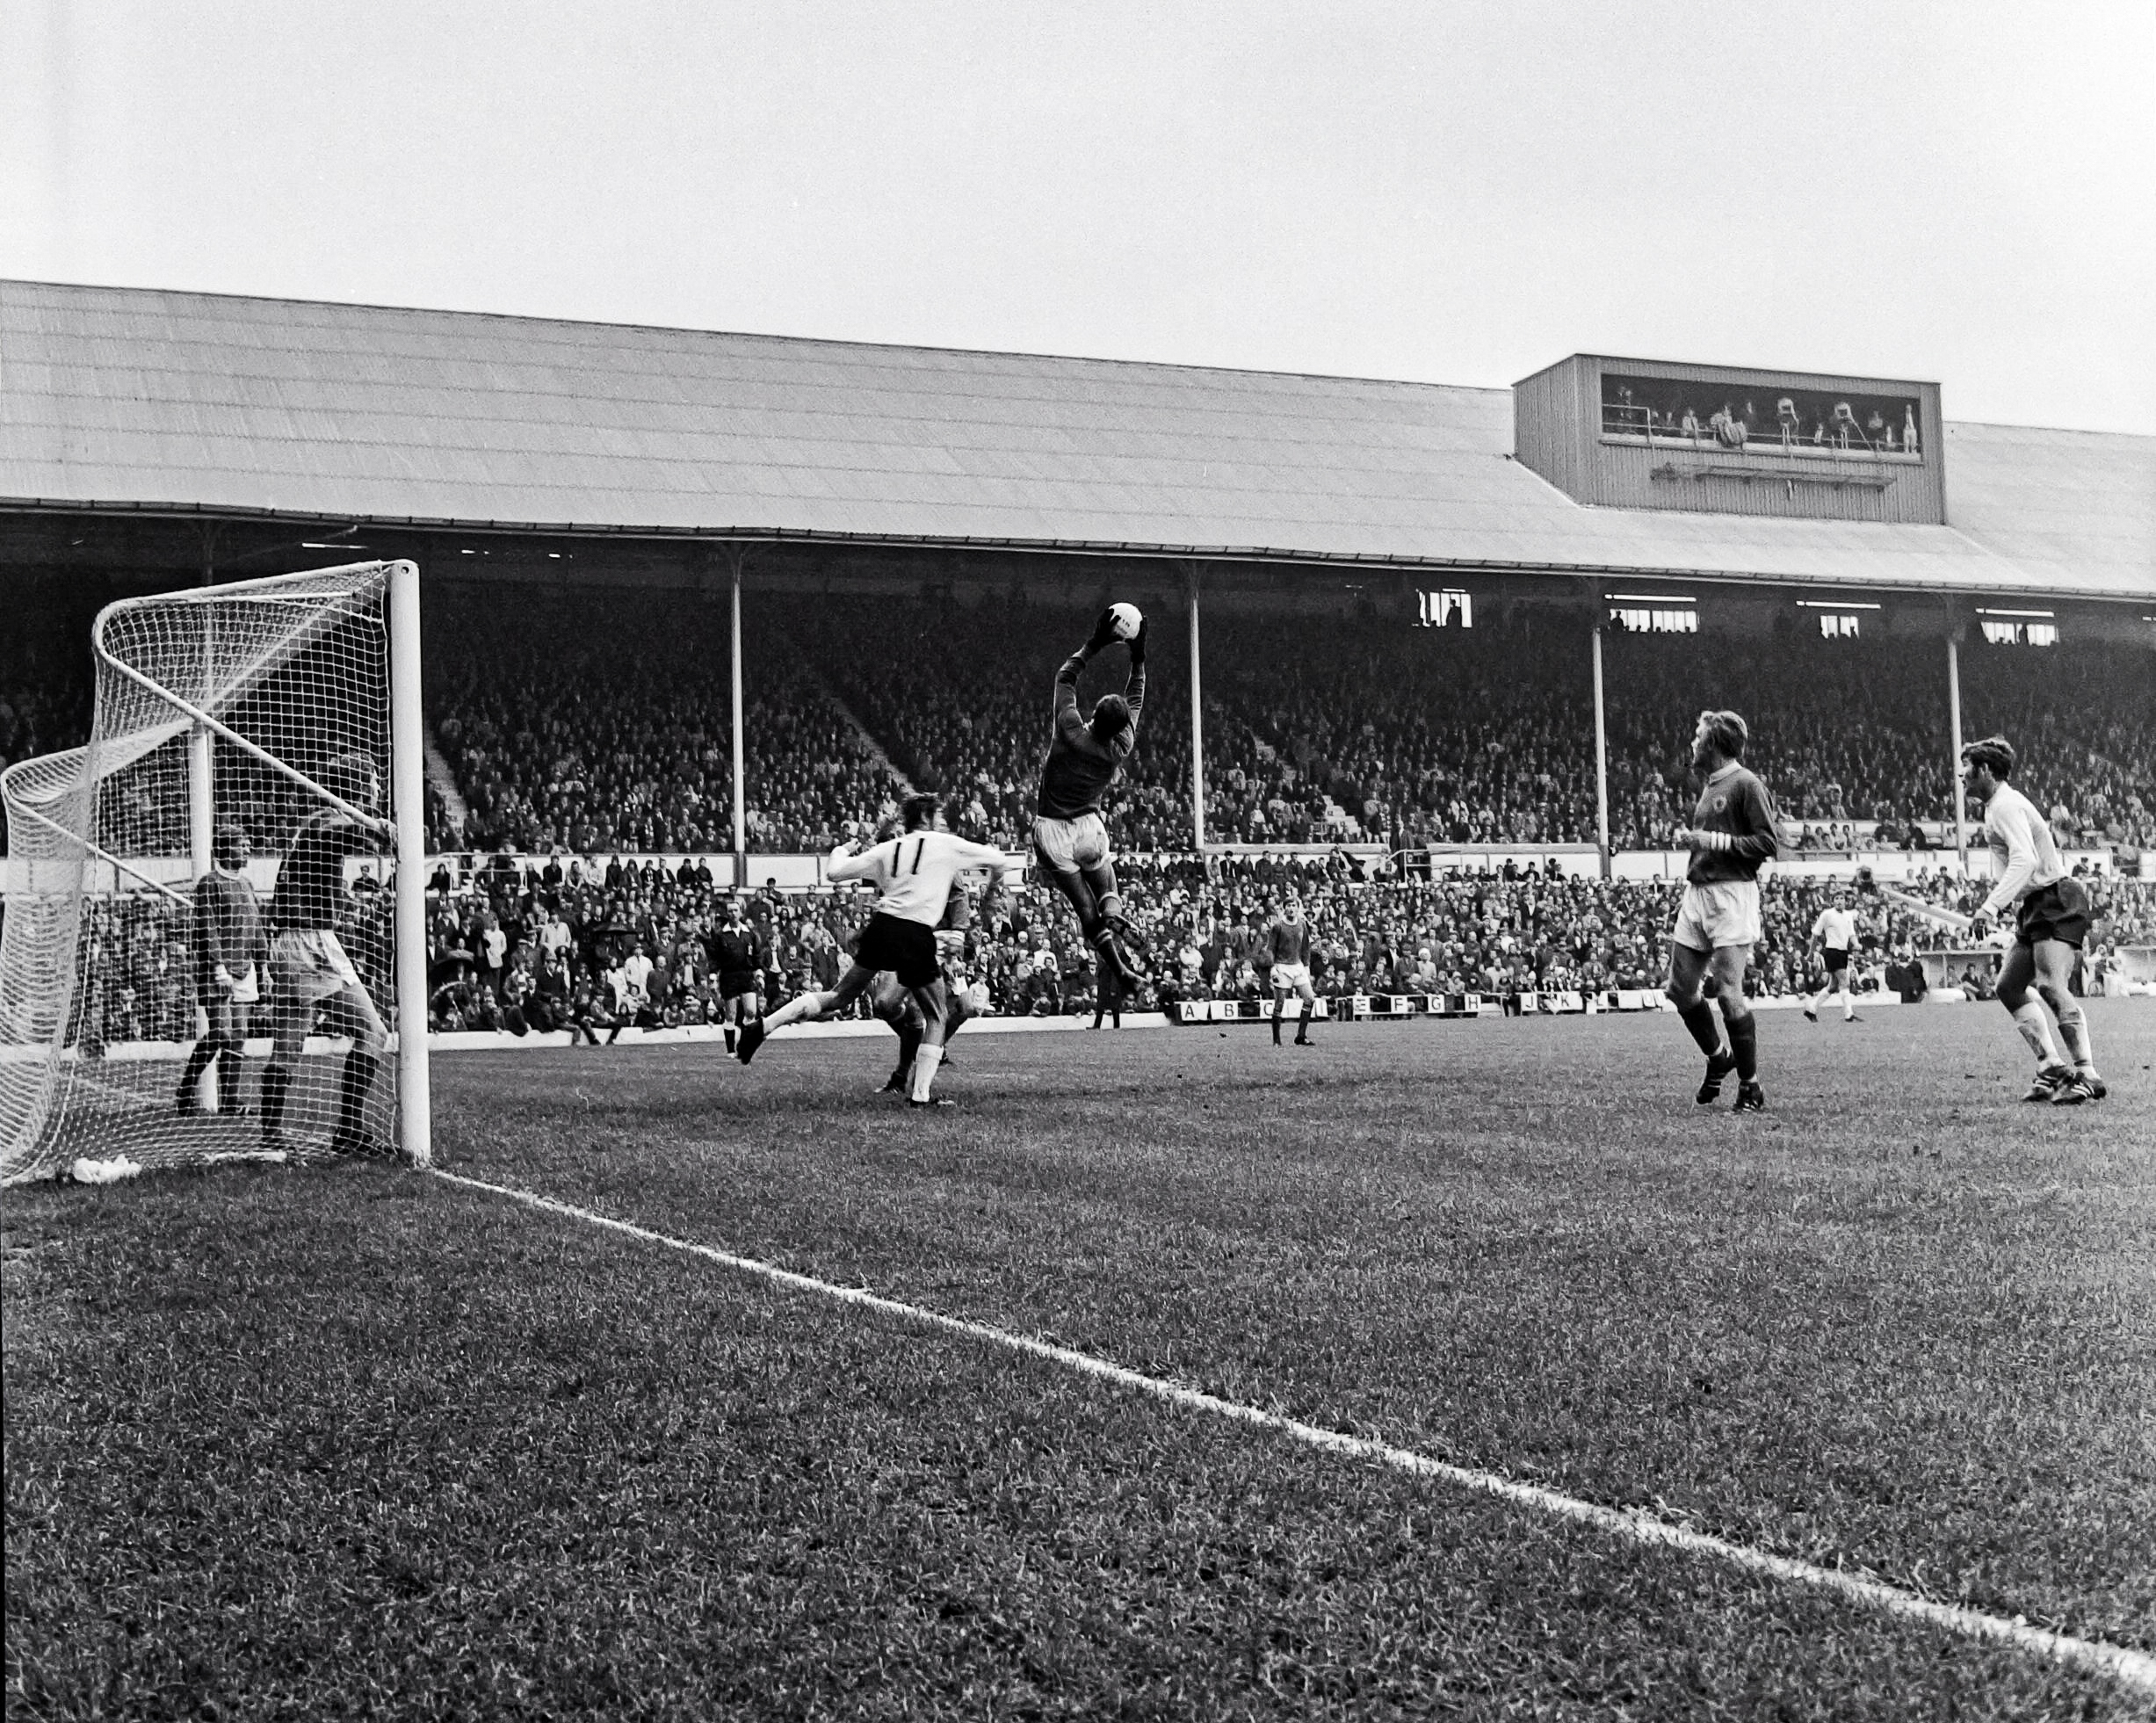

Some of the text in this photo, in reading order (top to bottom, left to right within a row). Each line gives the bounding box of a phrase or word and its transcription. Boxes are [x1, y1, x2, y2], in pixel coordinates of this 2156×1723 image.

[891, 838, 925, 878] 11
[1355, 996, 1479, 1011] E F G H
[1525, 995, 1534, 1008] J
[1561, 995, 1570, 1007] K
[1184, 1003, 1195, 1018] A
[1224, 1003, 1234, 1017] B
[1263, 1003, 1273, 1016] C
